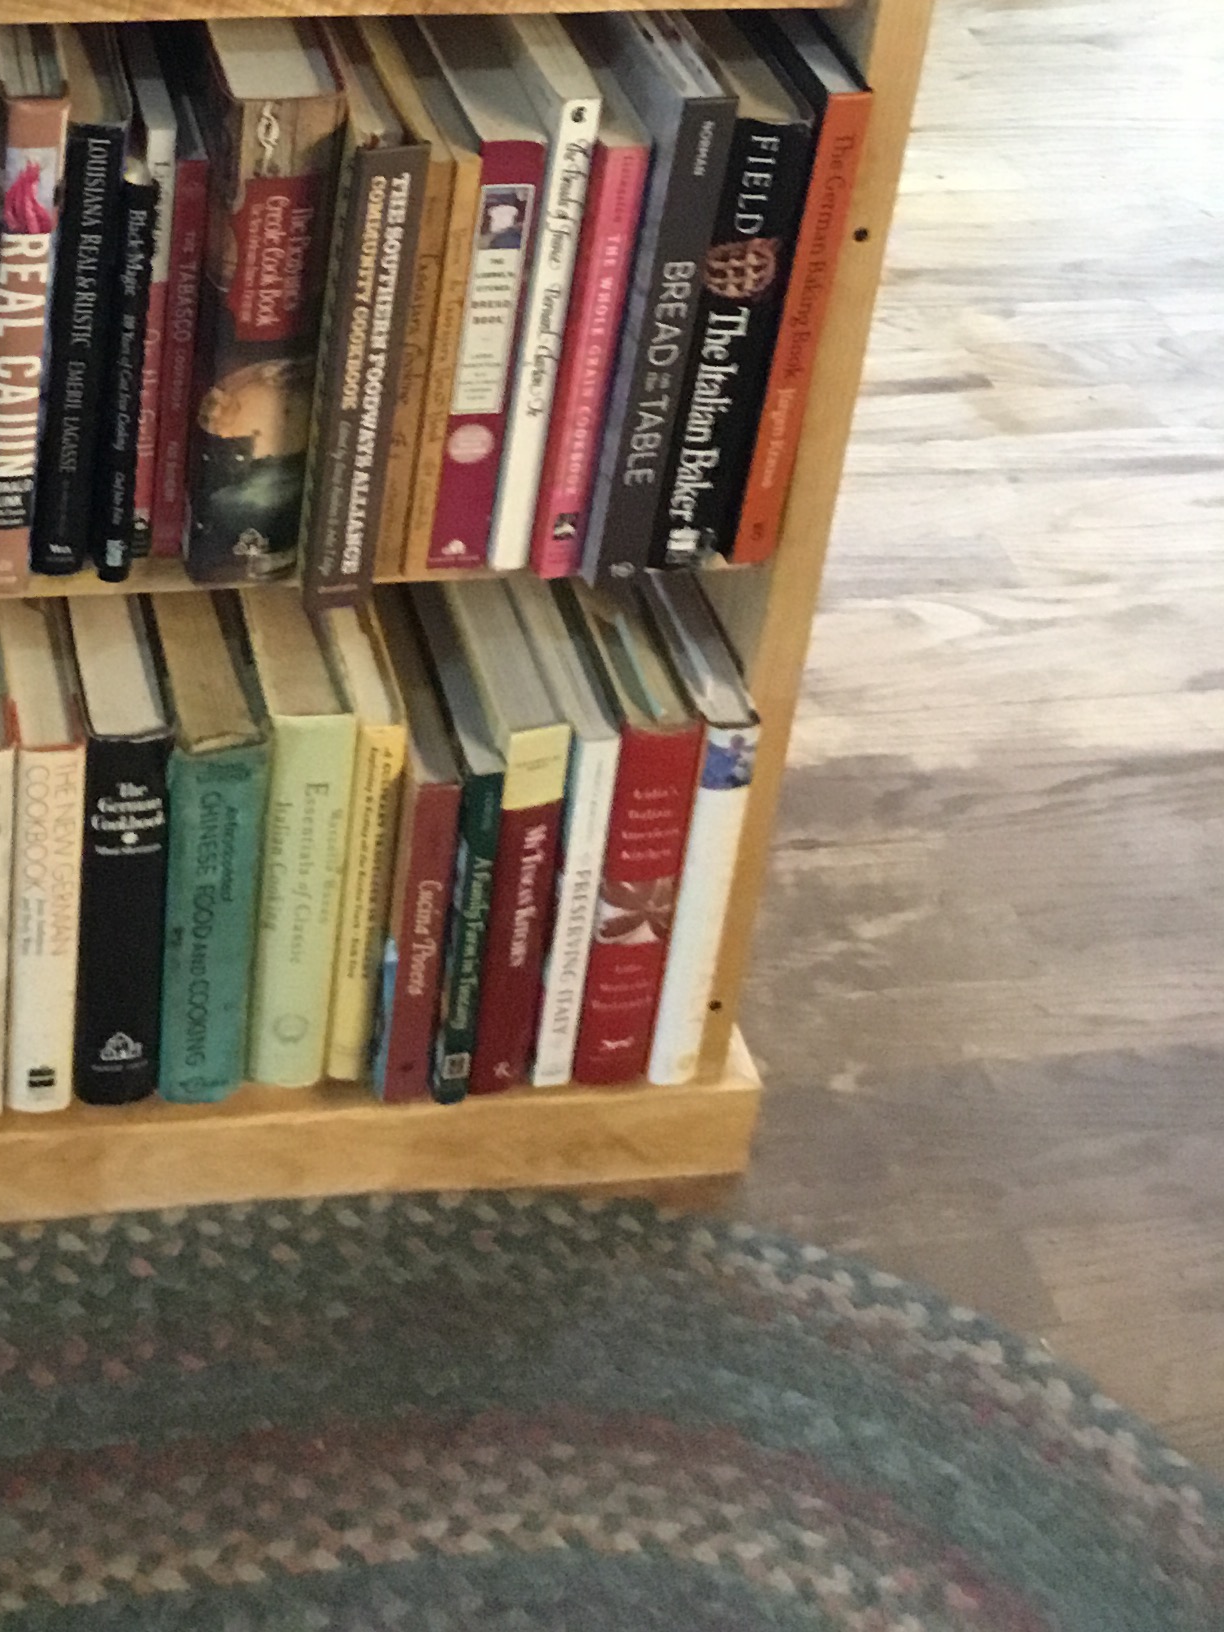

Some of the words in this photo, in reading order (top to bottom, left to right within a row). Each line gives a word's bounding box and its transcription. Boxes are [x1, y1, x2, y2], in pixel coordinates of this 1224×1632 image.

[80, 137, 112, 228] LOUISIANA
[732, 132, 781, 237] FIELD
[828, 133, 855, 170] The
[263, 194, 290, 247] Creole
[387, 170, 413, 225] THE
[810, 173, 845, 253] German
[76, 233, 102, 274] REAL
[259, 246, 284, 287] Cook
[354, 174, 388, 303] COMMUNITY
[75, 274, 95, 288] &
[255, 287, 280, 328] Book
[369, 224, 405, 350] SOUTHERN
[647, 256, 697, 367] BREAD
[789, 257, 827, 330] Baking
[68, 290, 97, 347] RUSTIC
[701, 300, 750, 364] The
[63, 360, 87, 411] EMERIL
[340, 305, 371, 411] COOKBOOK
[781, 328, 811, 383] Book
[353, 351, 388, 468] FOODWAYS
[683, 356, 739, 448] Italian
[58, 415, 80, 473] LAGASSE
[623, 389, 670, 490] TABLE
[667, 441, 721, 525] Baker
[339, 469, 372, 575] ALLIANCE
[53, 761, 79, 797] THE
[20, 764, 52, 894] COOKBOOK
[50, 801, 77, 856] NEW
[194, 789, 221, 876] CHINESE
[46, 861, 74, 956] GERMAN
[190, 883, 215, 939] FOOD
[559, 868, 591, 984] PRESERVING
[188, 942, 208, 977] AND
[181, 978, 209, 1066] COOKING
[551, 988, 574, 1035] ITALY
